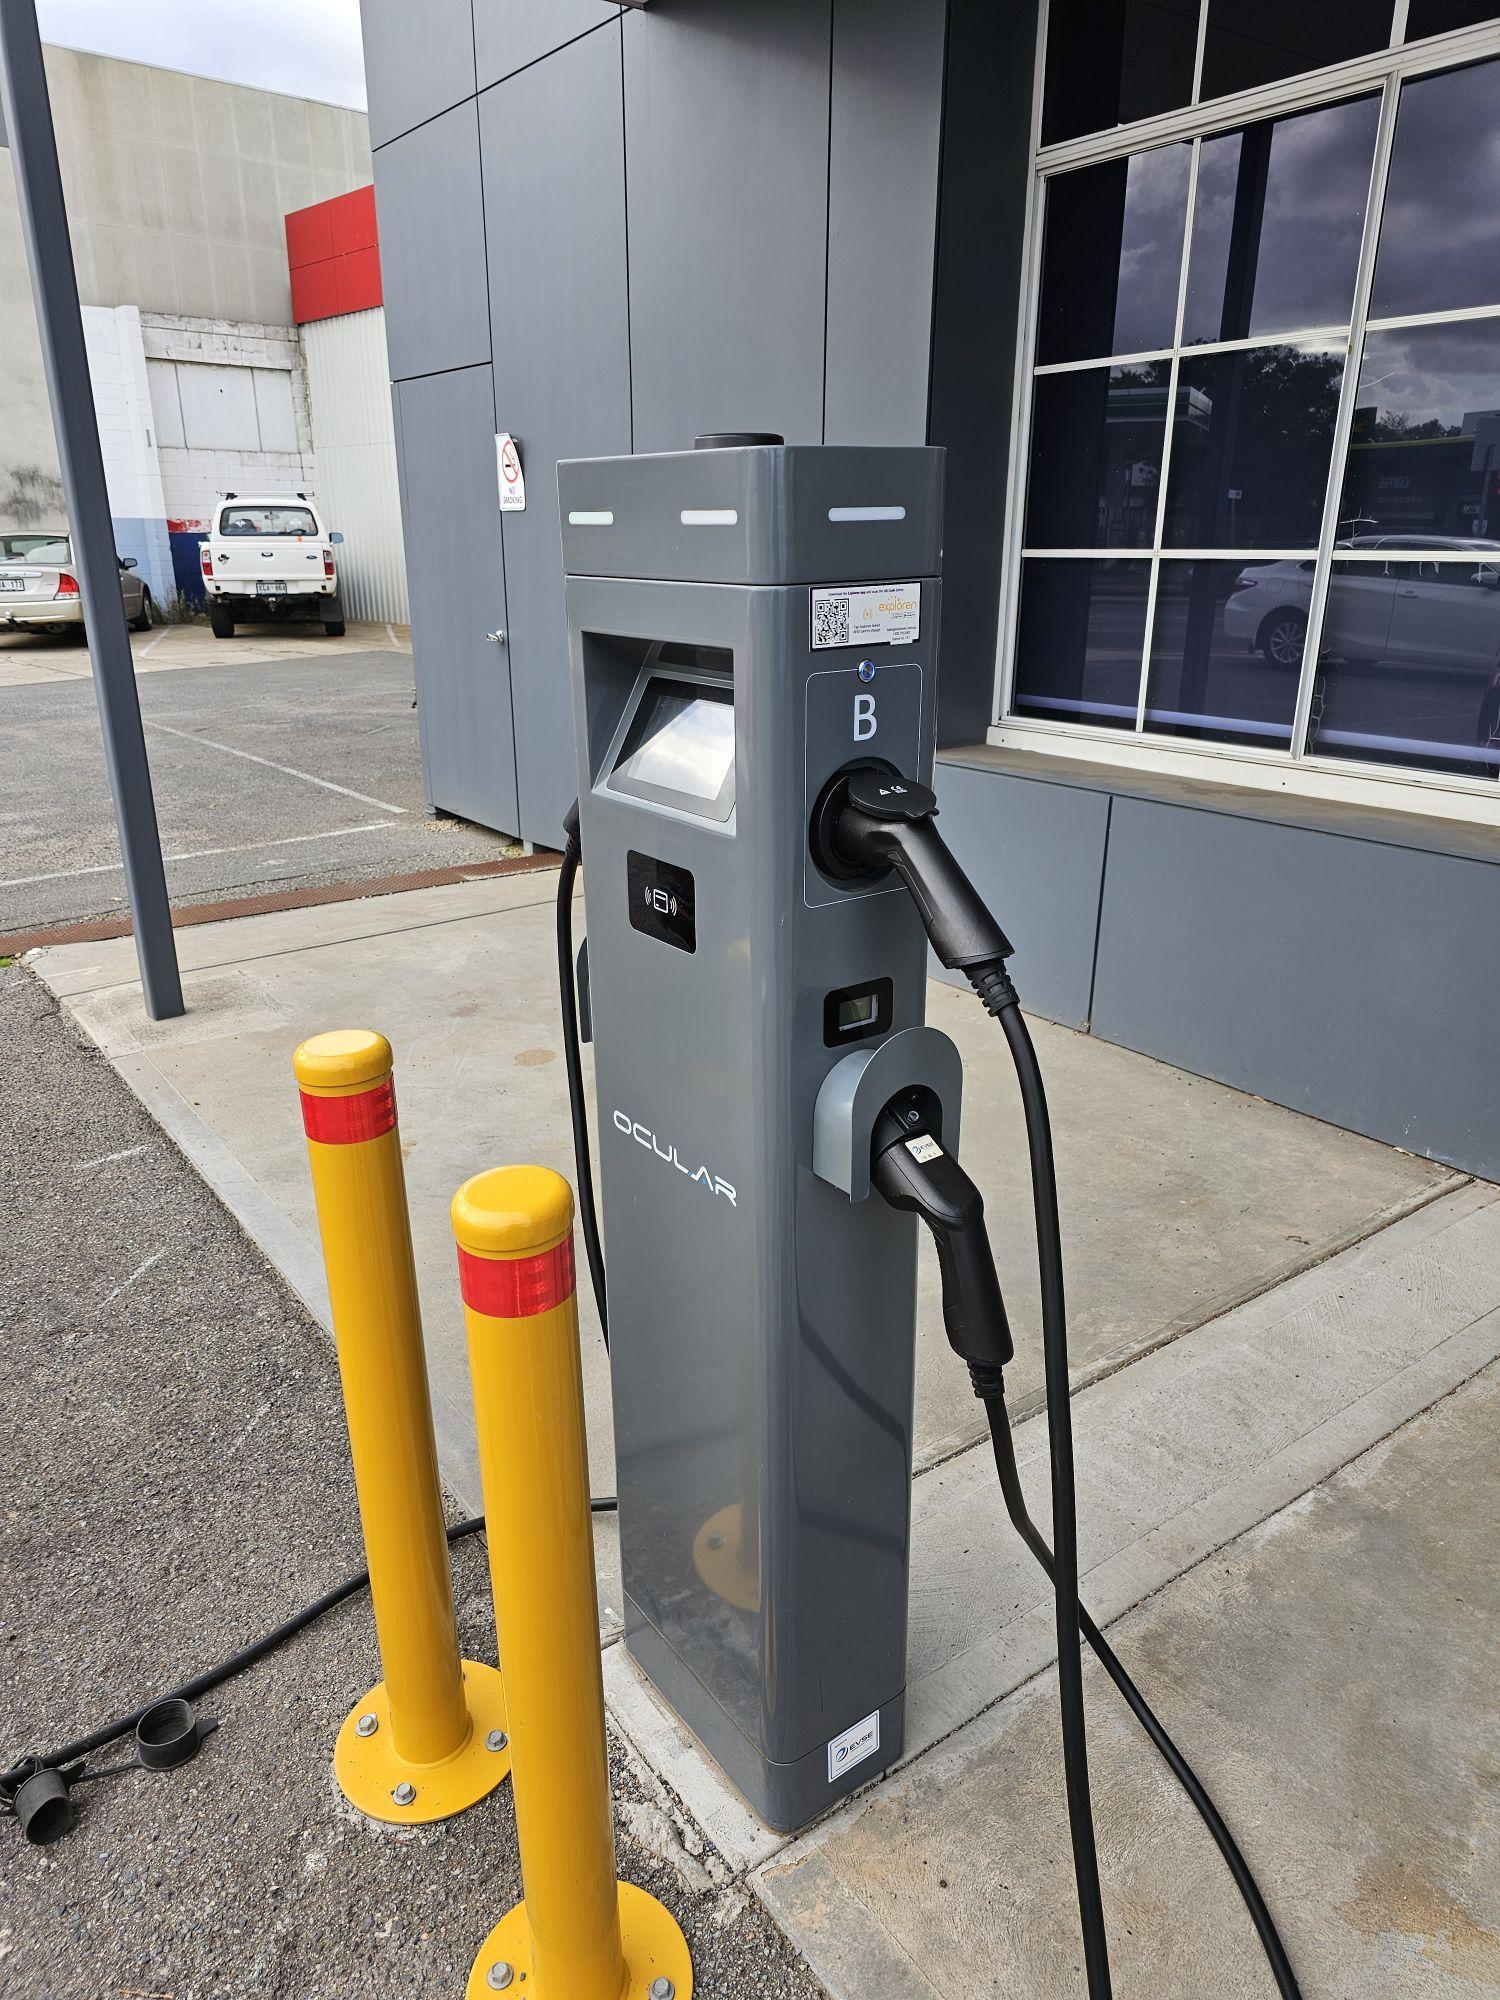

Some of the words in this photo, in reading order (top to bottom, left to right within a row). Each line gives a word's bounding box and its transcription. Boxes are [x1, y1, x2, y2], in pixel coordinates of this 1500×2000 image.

[508, 486, 516, 495] NO
[503, 496, 523, 504] SMOKING
[879, 599, 917, 614] exploren
[853, 694, 878, 742] B
[613, 1110, 738, 1208] OCULAR
[849, 1730, 874, 1751] EVSE
